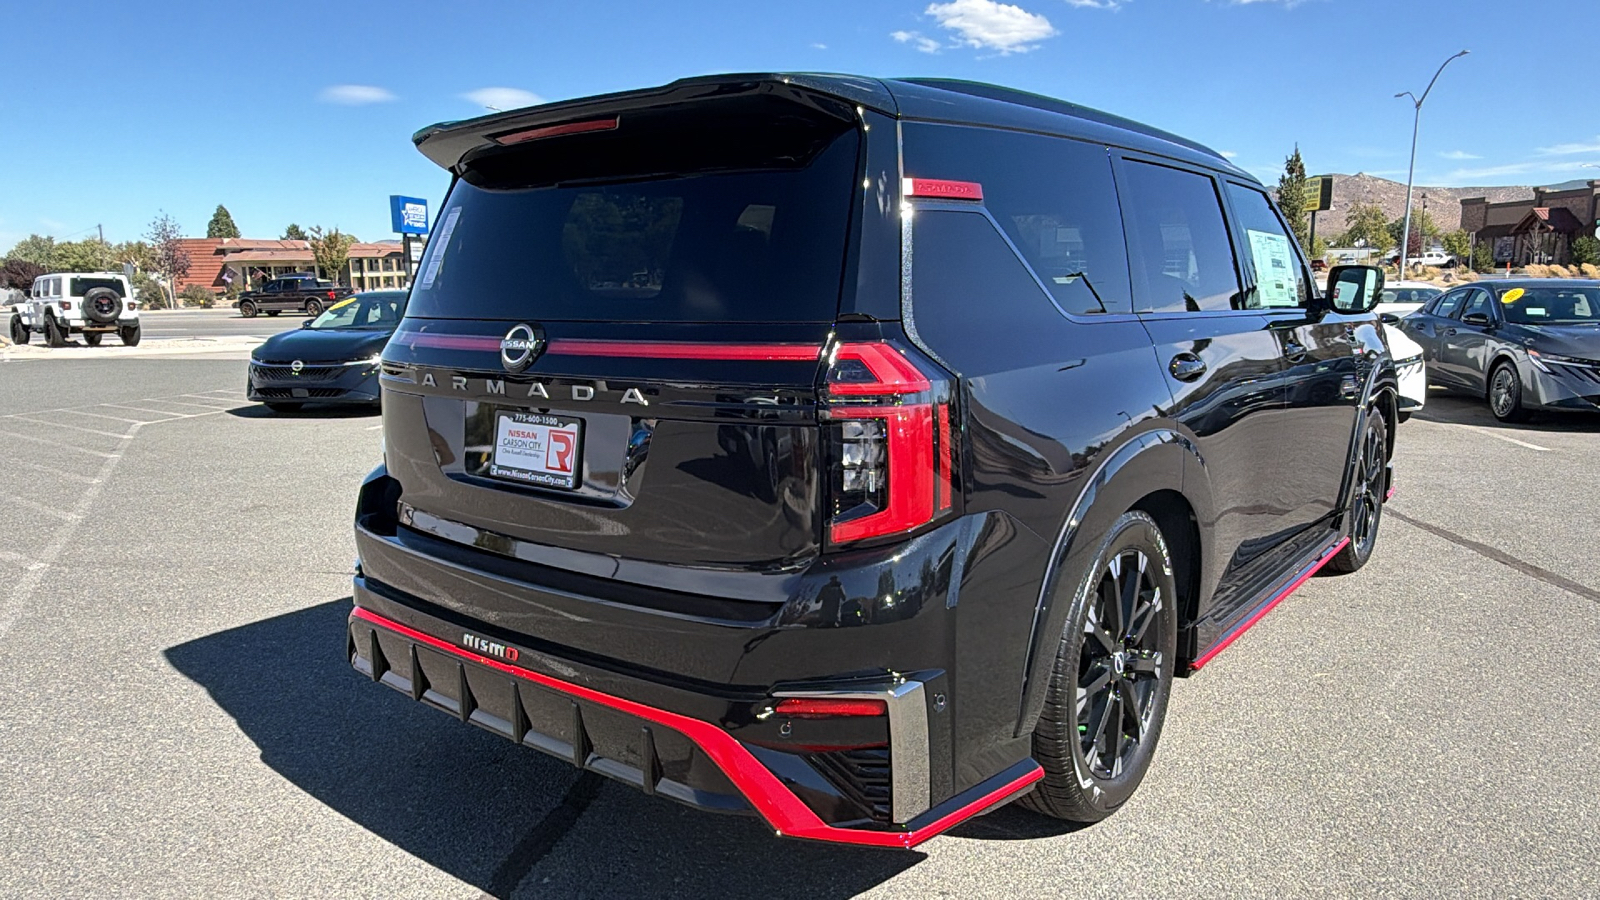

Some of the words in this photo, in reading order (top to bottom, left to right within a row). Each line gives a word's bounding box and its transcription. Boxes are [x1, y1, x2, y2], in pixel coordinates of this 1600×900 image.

[421, 373, 649, 406] ARMADA
[515, 413, 558, 425] 775-600-1500
[508, 429, 537, 440] NISSAN
[503, 438, 528, 448] CARSON
[528, 441, 542, 450] CITY
[497, 468, 566, 486] www.NissanCarsonCity.com
